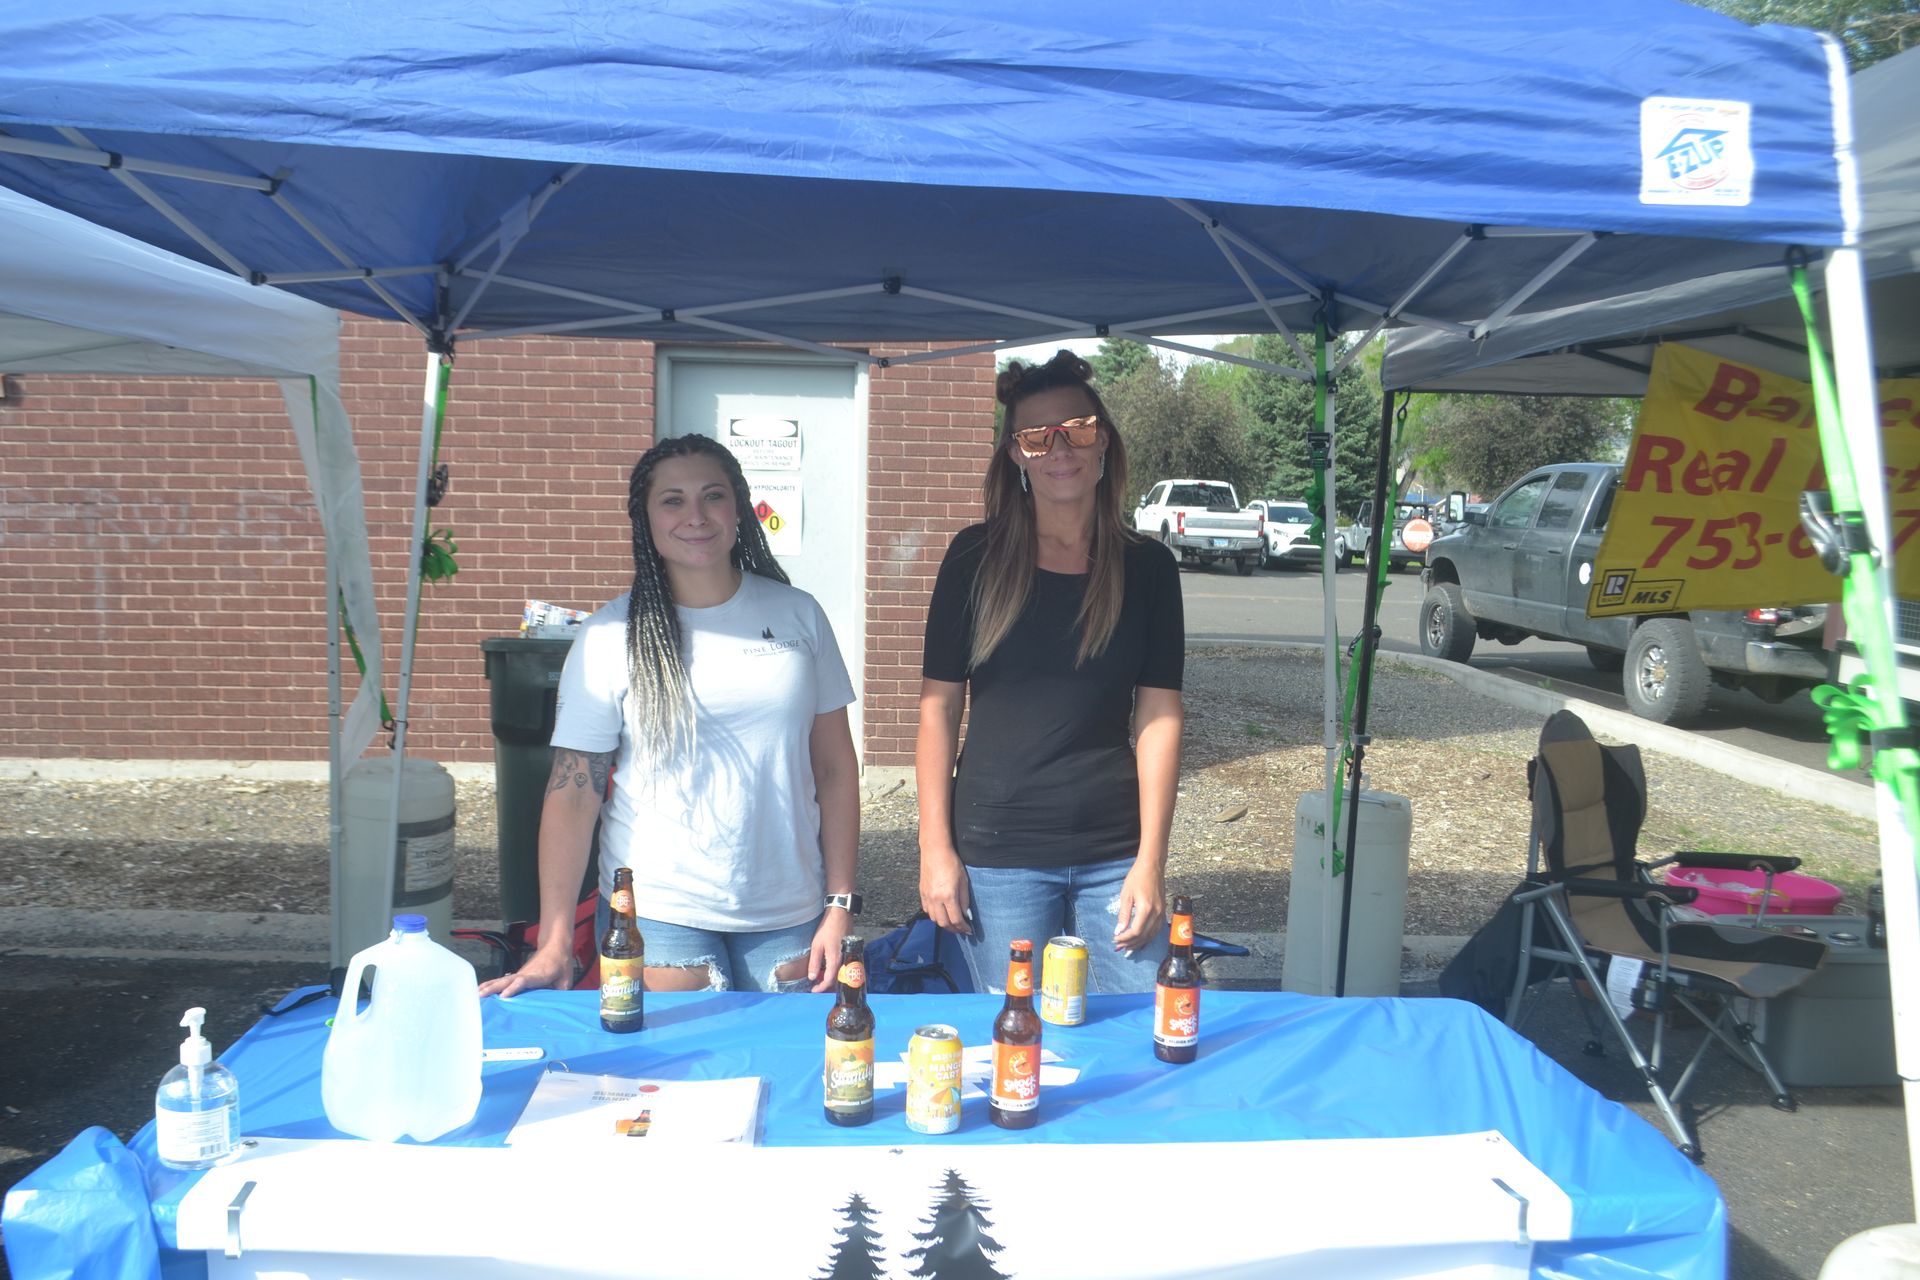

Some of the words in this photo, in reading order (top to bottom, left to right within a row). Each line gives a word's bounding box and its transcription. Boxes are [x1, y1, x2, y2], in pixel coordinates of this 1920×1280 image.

[1625, 434, 1787, 496] Real
[757, 503, 768, 518] 0
[769, 516, 780, 531] 0
[1632, 590, 1672, 604] MLS
[770, 639, 801, 651] LODGE
[1169, 1016, 1197, 1031] SHOCK
[1003, 1075, 1036, 1093] SHOCK
